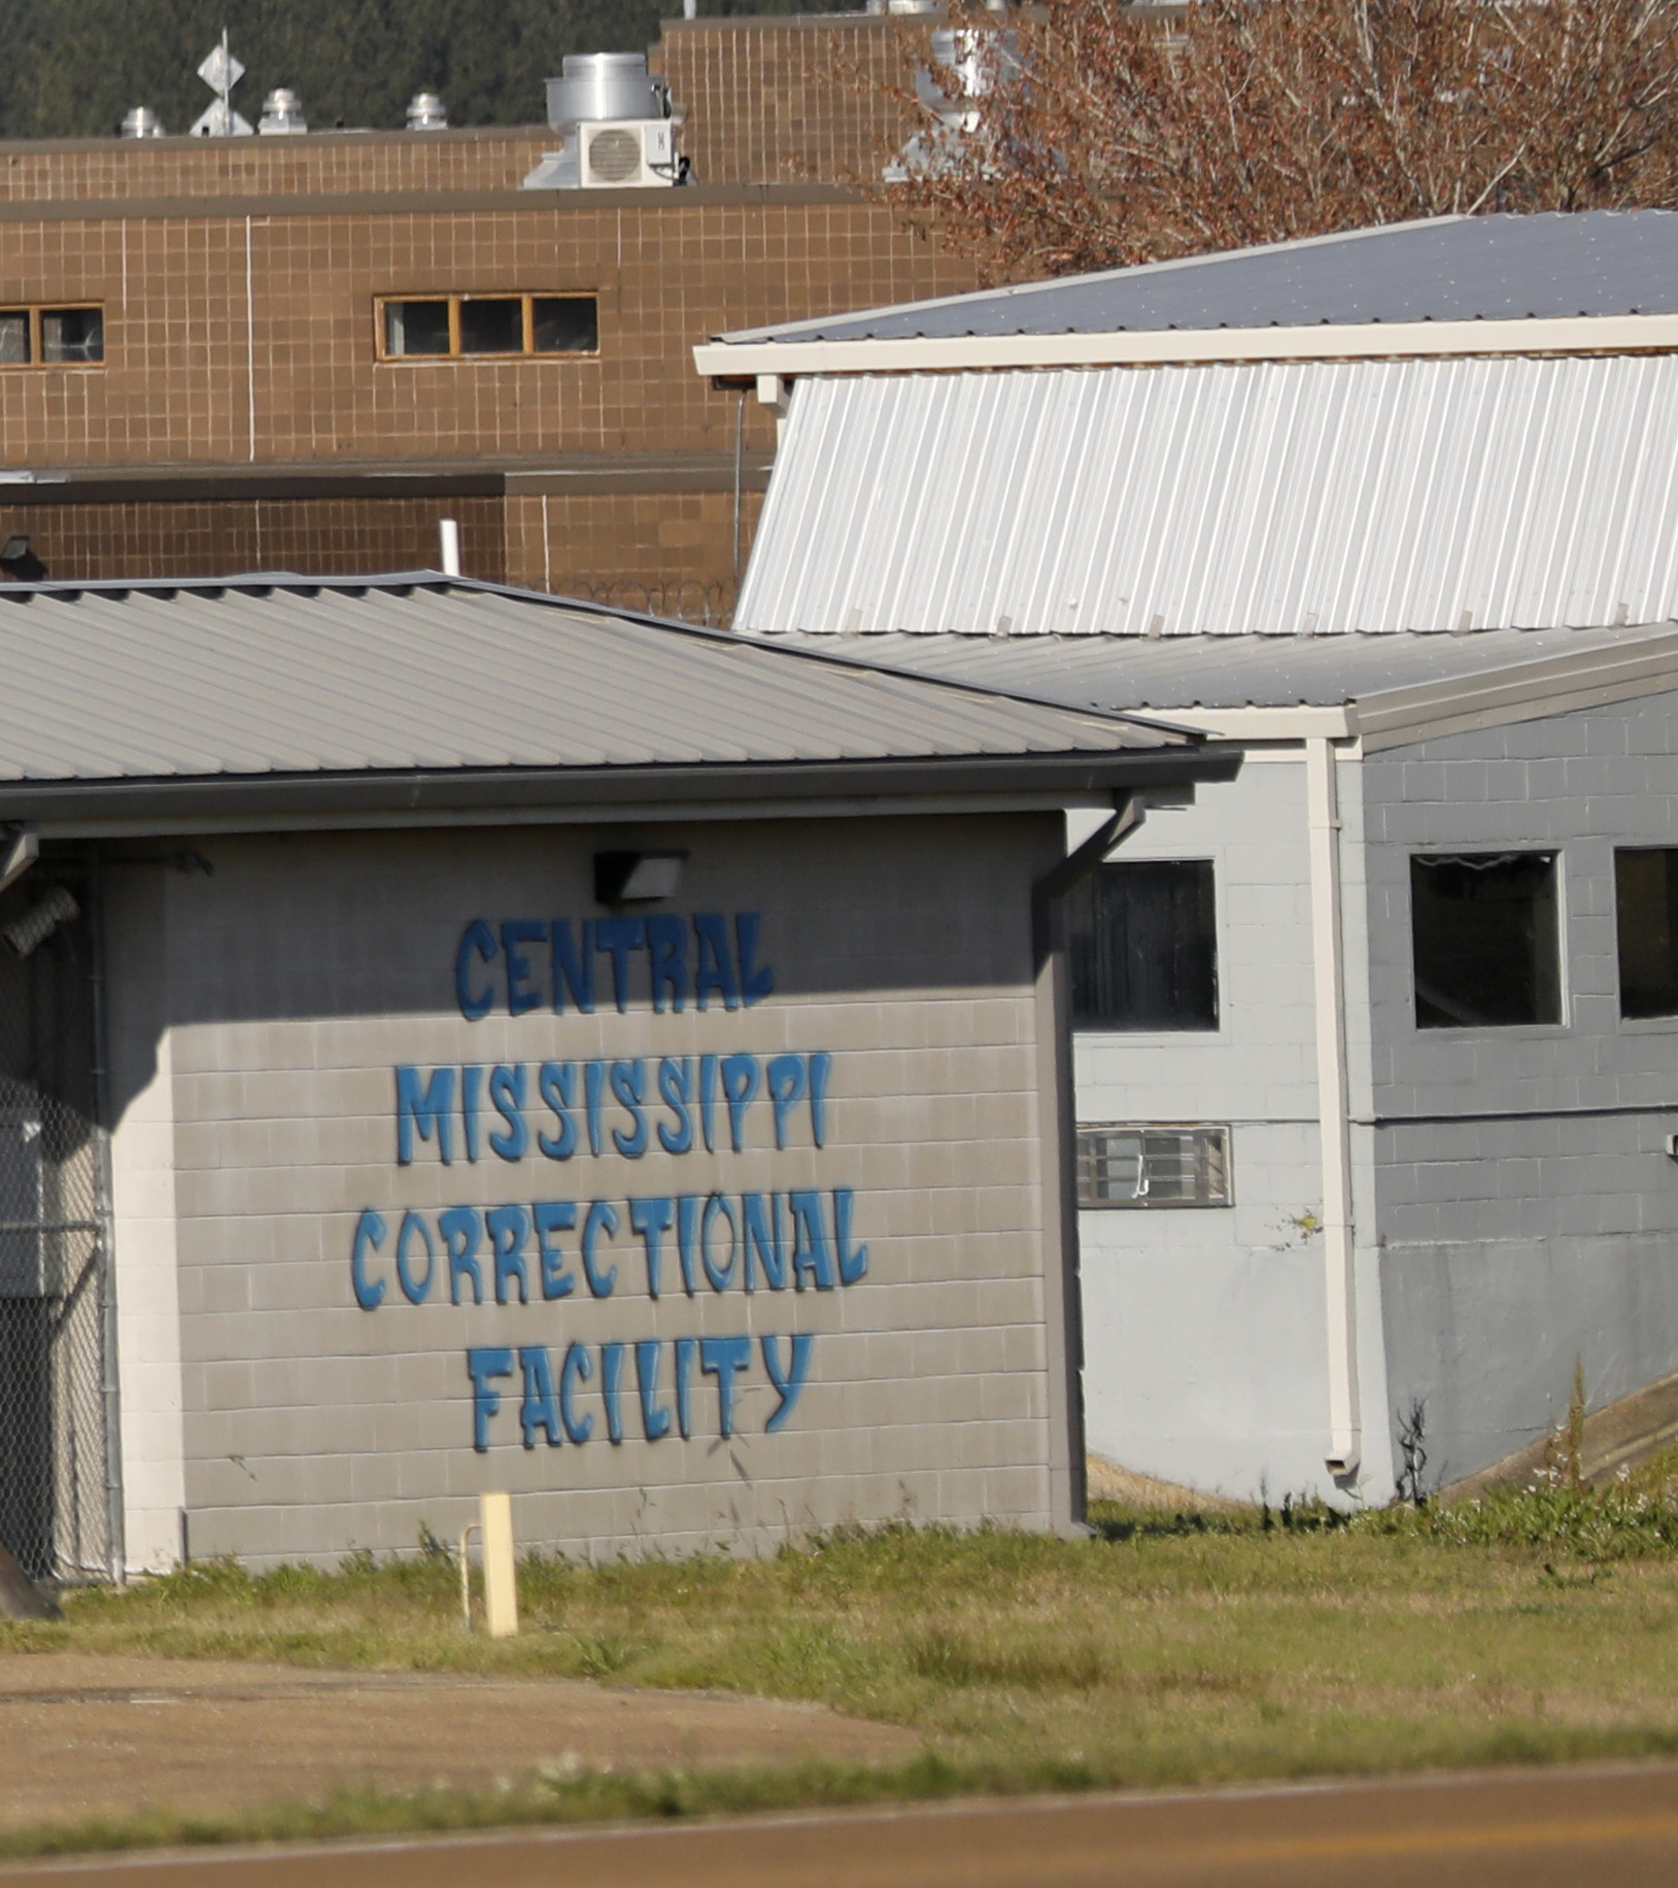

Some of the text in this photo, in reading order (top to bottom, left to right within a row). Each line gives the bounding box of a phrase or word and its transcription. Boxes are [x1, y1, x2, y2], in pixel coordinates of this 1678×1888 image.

[455, 912, 774, 1021] CENTRAL
[395, 1052, 830, 1165] MISSISSIPPI
[352, 1188, 867, 1311] CORRECTIONAL
[468, 1335, 813, 1452] FACILITY
